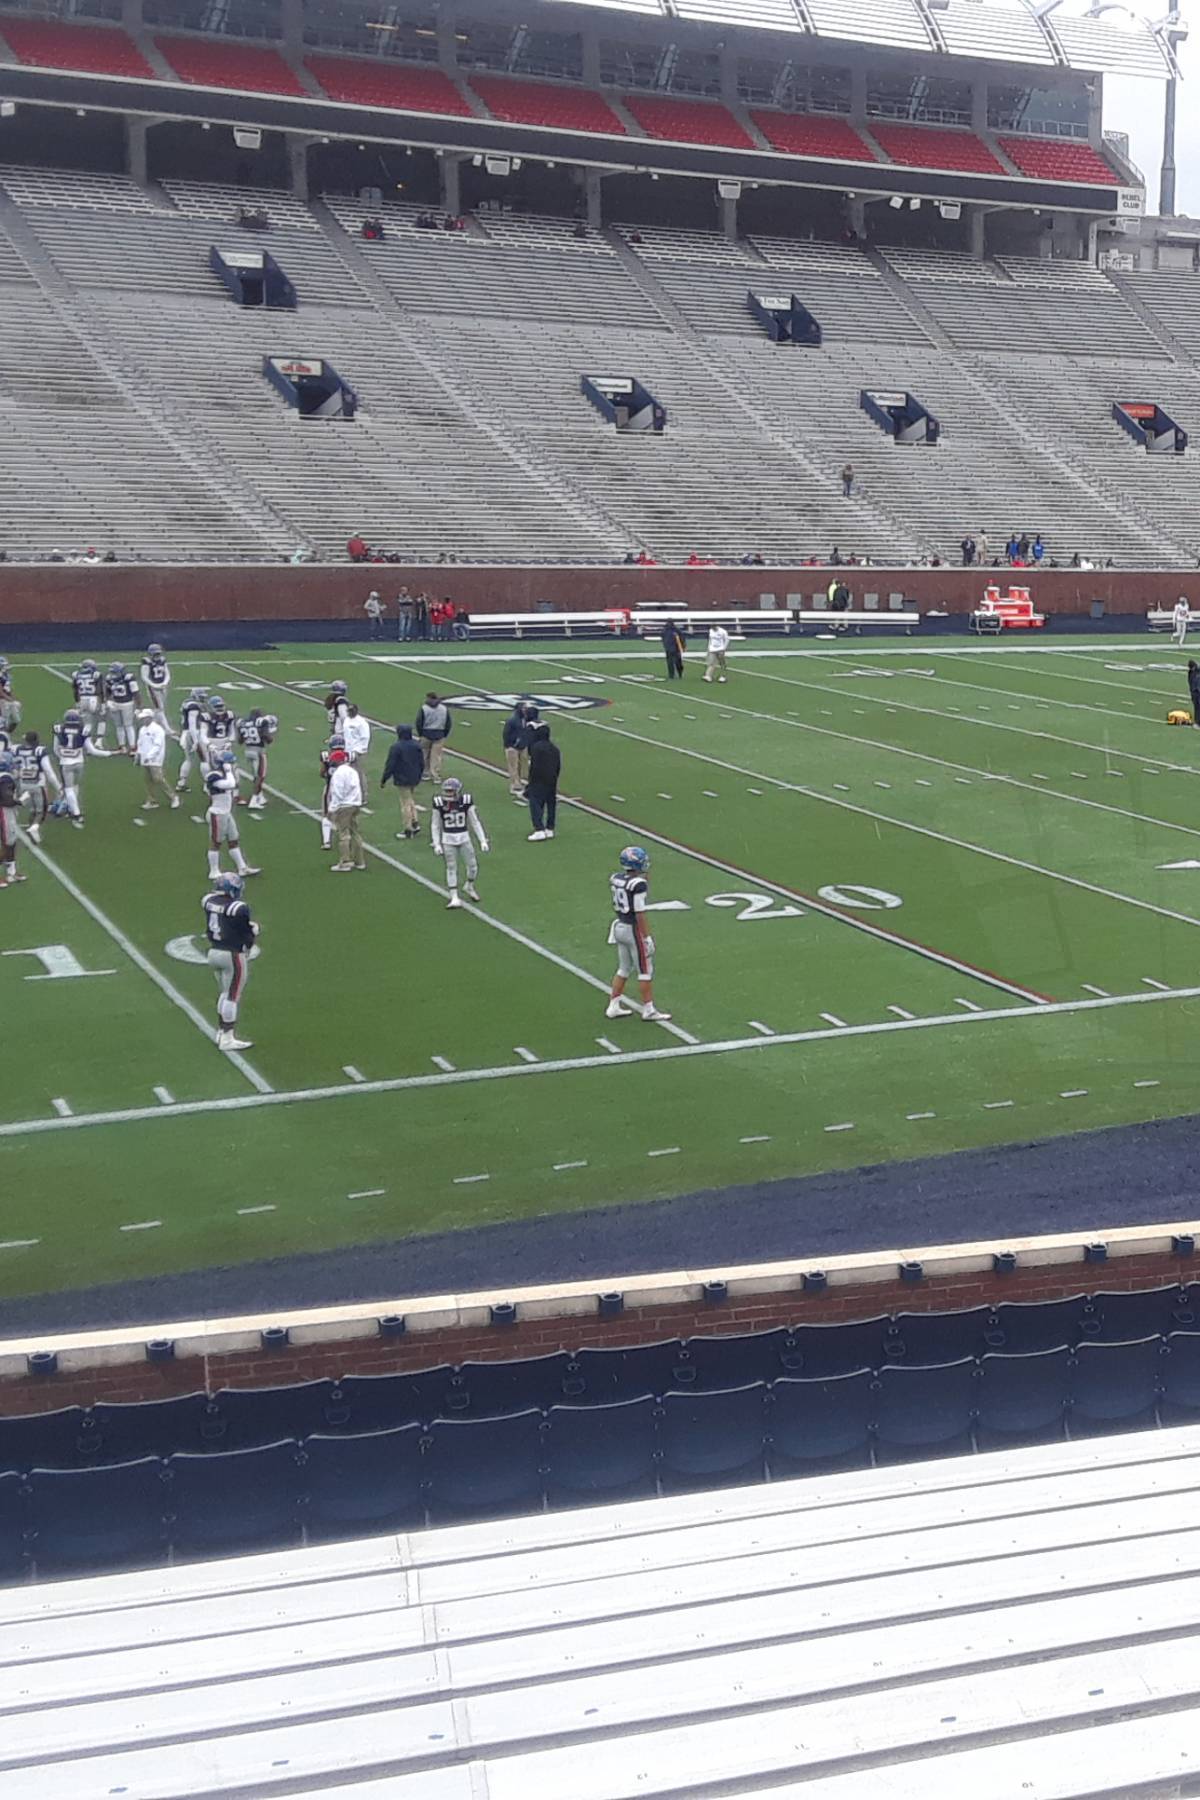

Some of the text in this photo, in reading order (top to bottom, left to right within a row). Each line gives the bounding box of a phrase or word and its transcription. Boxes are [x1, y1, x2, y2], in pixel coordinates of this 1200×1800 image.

[1123, 201, 1140, 209] CLUB
[443, 812, 466, 829] 20
[705, 884, 902, 921] 20
[208, 912, 222, 942] 4
